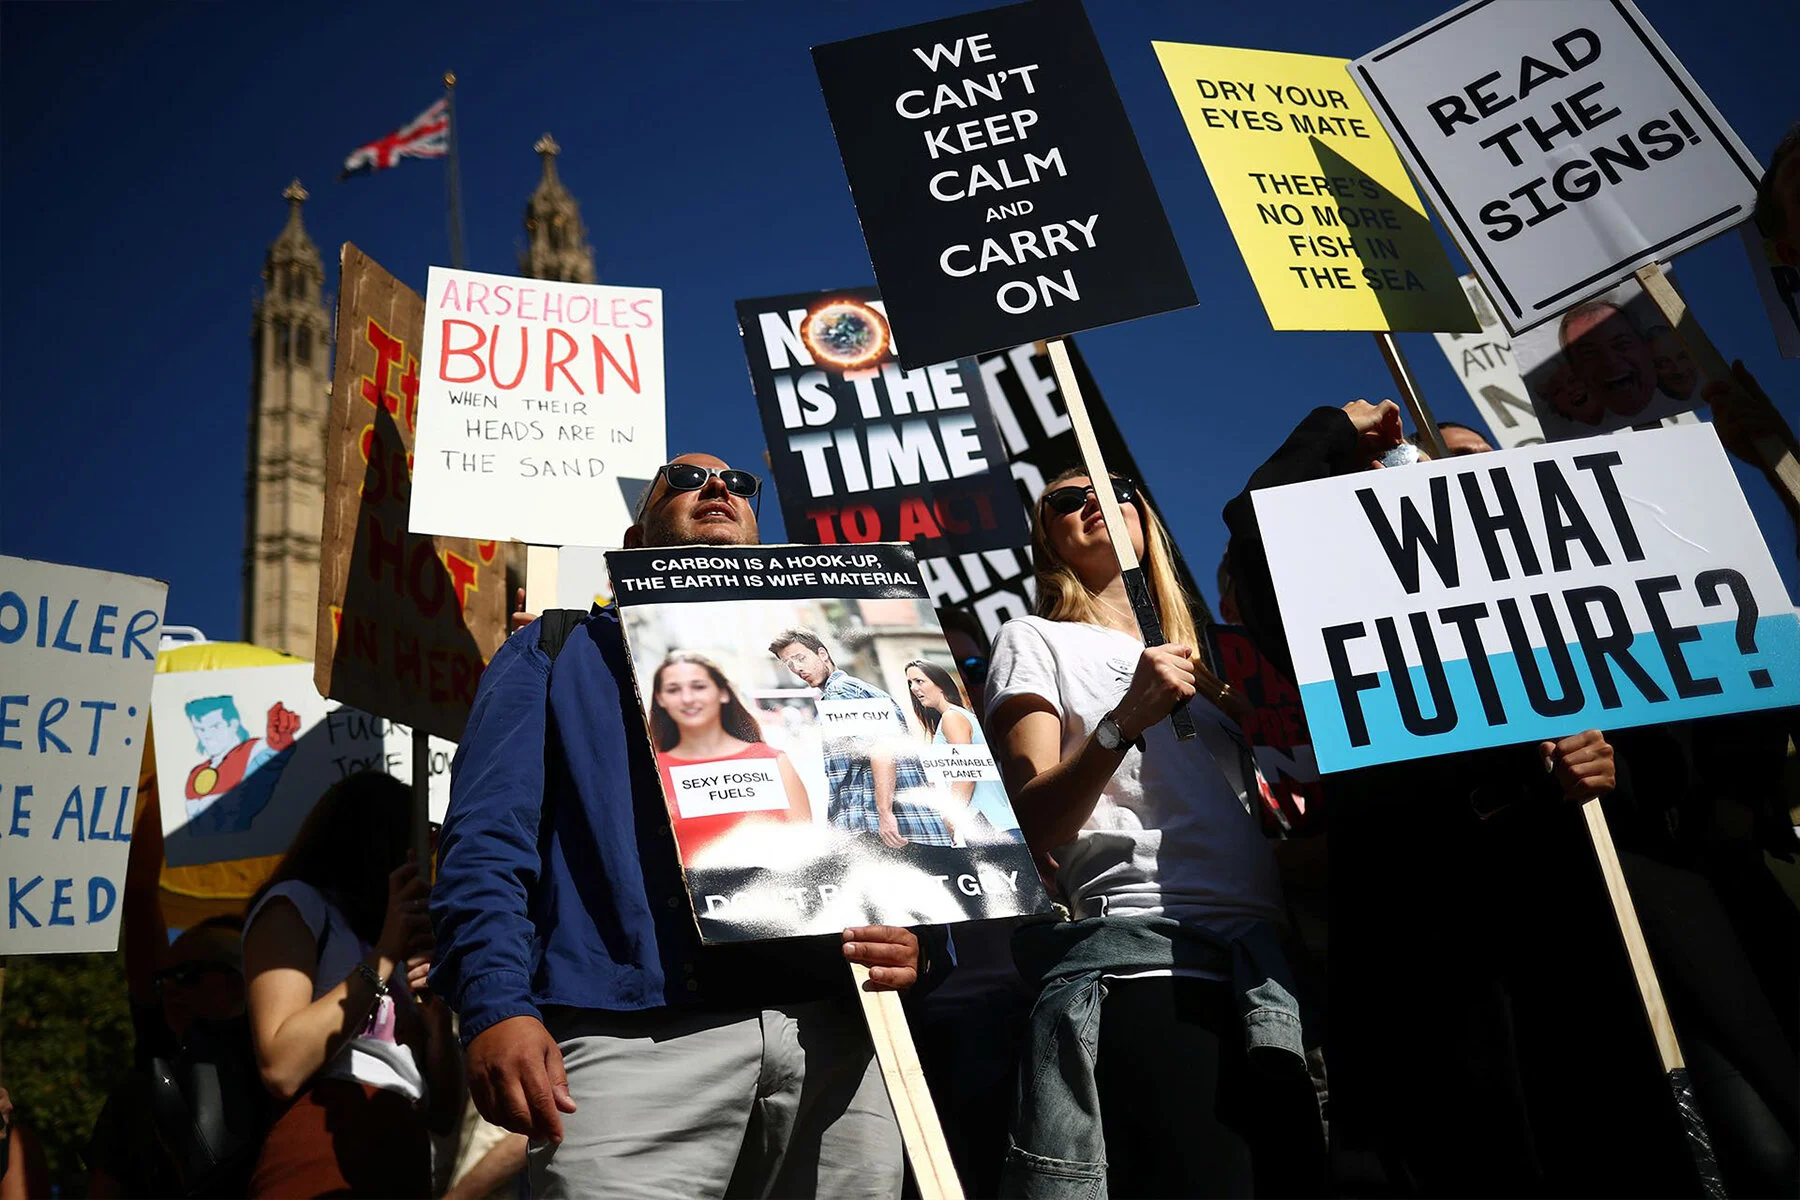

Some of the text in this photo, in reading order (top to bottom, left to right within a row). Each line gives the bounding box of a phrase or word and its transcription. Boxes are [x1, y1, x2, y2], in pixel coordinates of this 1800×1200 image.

[912, 33, 996, 73] WE
[895, 64, 1039, 120] CAN'T
[1196, 79, 1349, 110] DRY YOUR
[1426, 27, 1602, 137] READ
[924, 109, 1039, 159] KEEP
[1201, 108, 1370, 138] EYES MATE
[1478, 81, 1622, 167] THE
[929, 147, 1068, 202] CALM
[1248, 172, 1380, 199] THERE'S
[1478, 109, 1702, 242] SIGNS!
[985, 200, 1034, 223] AND
[1256, 203, 1402, 230] NO MORE
[939, 214, 1099, 278] CARRY
[1288, 235, 1400, 260] FISH IN
[996, 269, 1080, 315] ON
[1289, 266, 1427, 292] THE SEA
[440, 279, 654, 328] ARSEHOLES
[439, 319, 641, 395] BURN
[449, 391, 588, 416] WHEN THEIR
[774, 361, 970, 429] IS THE
[467, 419, 635, 444] HEADS ARE IN
[440, 449, 605, 479] THE SAND
[788, 414, 989, 498] TIME
[805, 503, 882, 544] TO
[900, 492, 998, 542] ACT
[1354, 450, 1646, 595] WHAT
[368, 515, 479, 629] HOT
[651, 554, 882, 571] CARBON IS A HOOK-UP,
[622, 571, 918, 591] THE EARTH IS WIFE MATERIAL
[1321, 568, 1775, 748] FUTURE?
[825, 710, 889, 722] THAT GUY
[923, 758, 994, 769] SUSTAINABLE
[951, 748, 960, 756] A
[682, 770, 774, 790] SEXY FOSSIL
[943, 769, 983, 779] PLANET
[709, 786, 756, 801] FUELS
[53, 785, 131, 842] ALL
